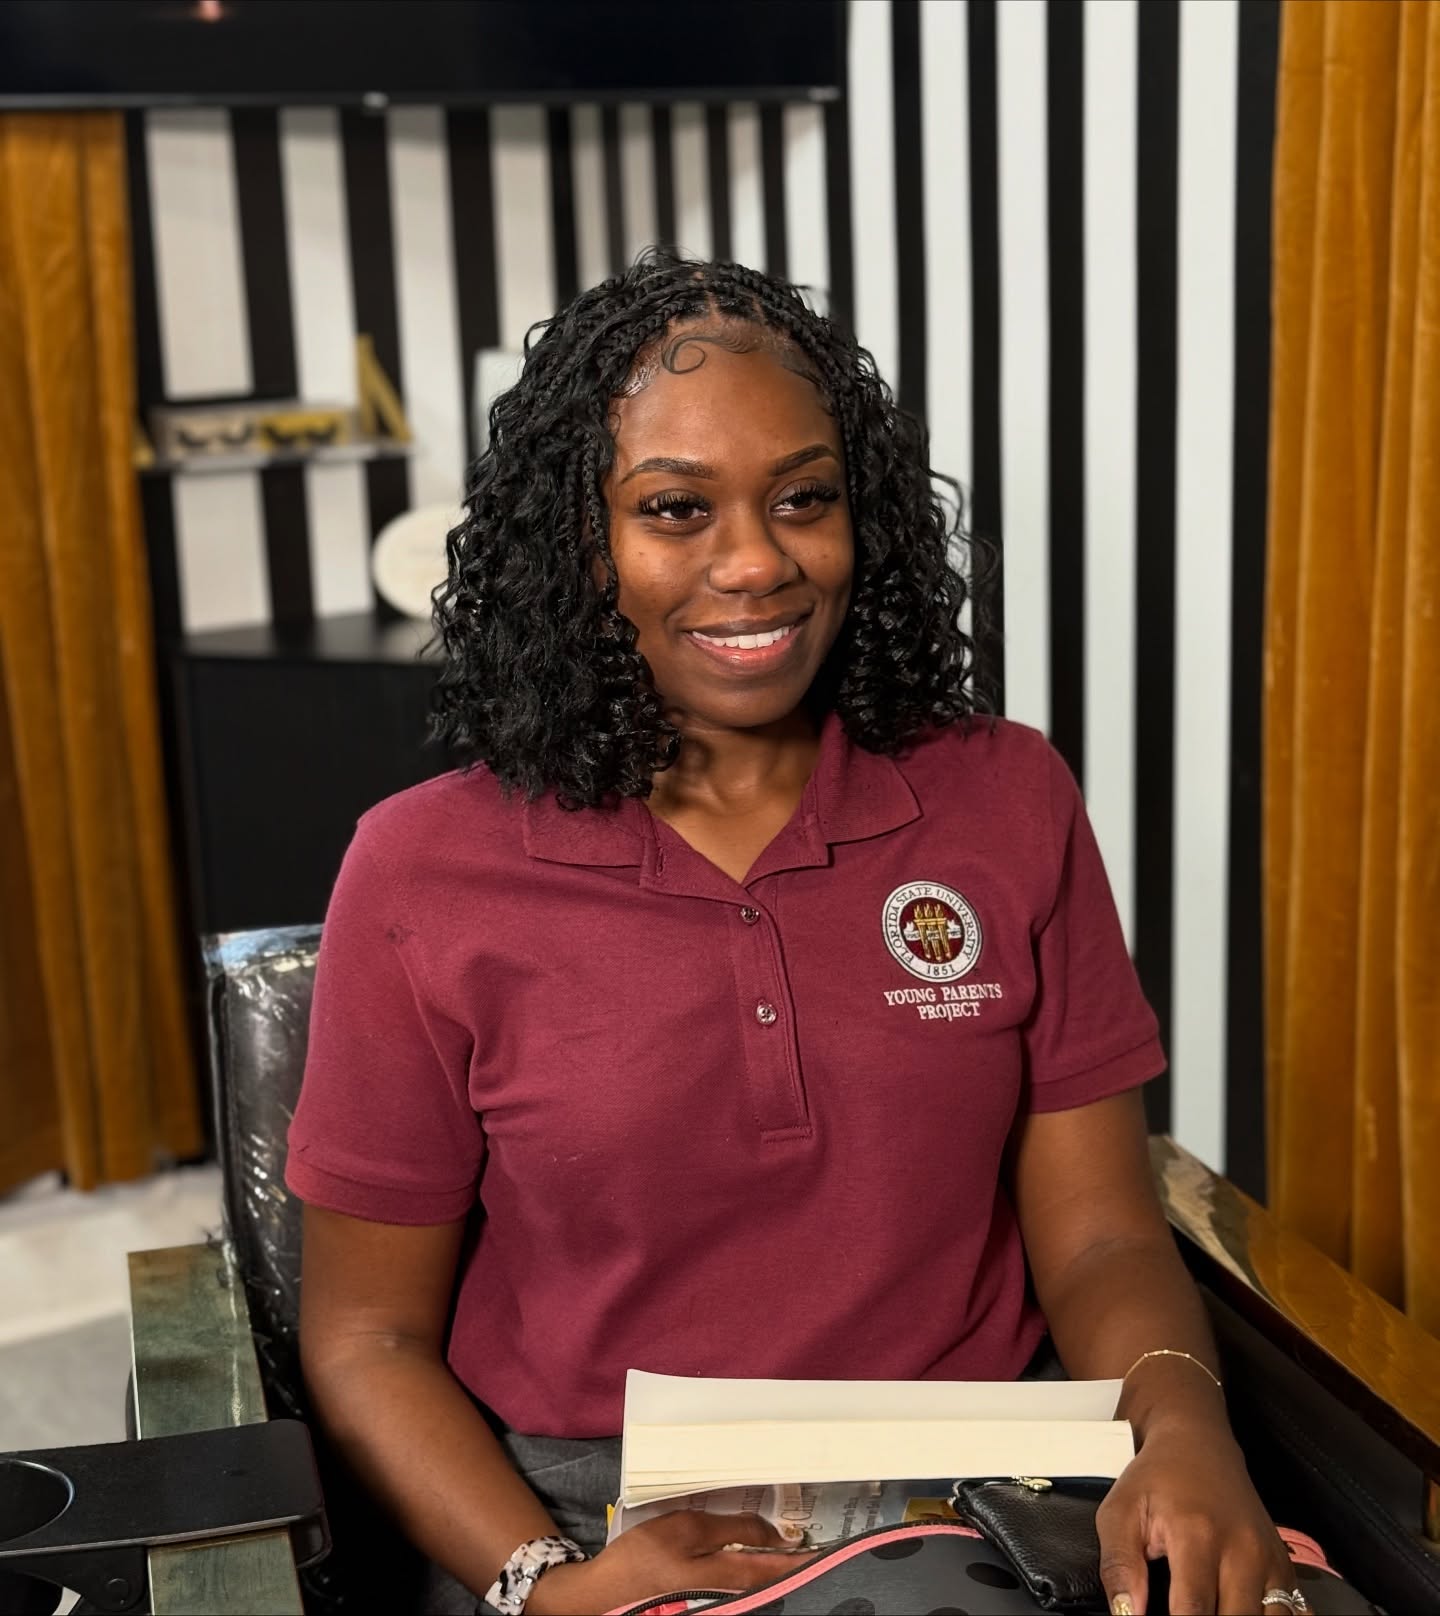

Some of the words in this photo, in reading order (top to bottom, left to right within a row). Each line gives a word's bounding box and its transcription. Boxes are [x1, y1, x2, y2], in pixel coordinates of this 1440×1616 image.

[895, 886, 933, 905] STATE
[936, 889, 976, 960] UNIVERSITY
[888, 906, 915, 965] FLORIDA
[926, 964, 956, 977] 1851
[883, 987, 936, 1006] YOUNG
[940, 983, 1003, 1001] PARENTS
[916, 1002, 981, 1022] PROJECT
